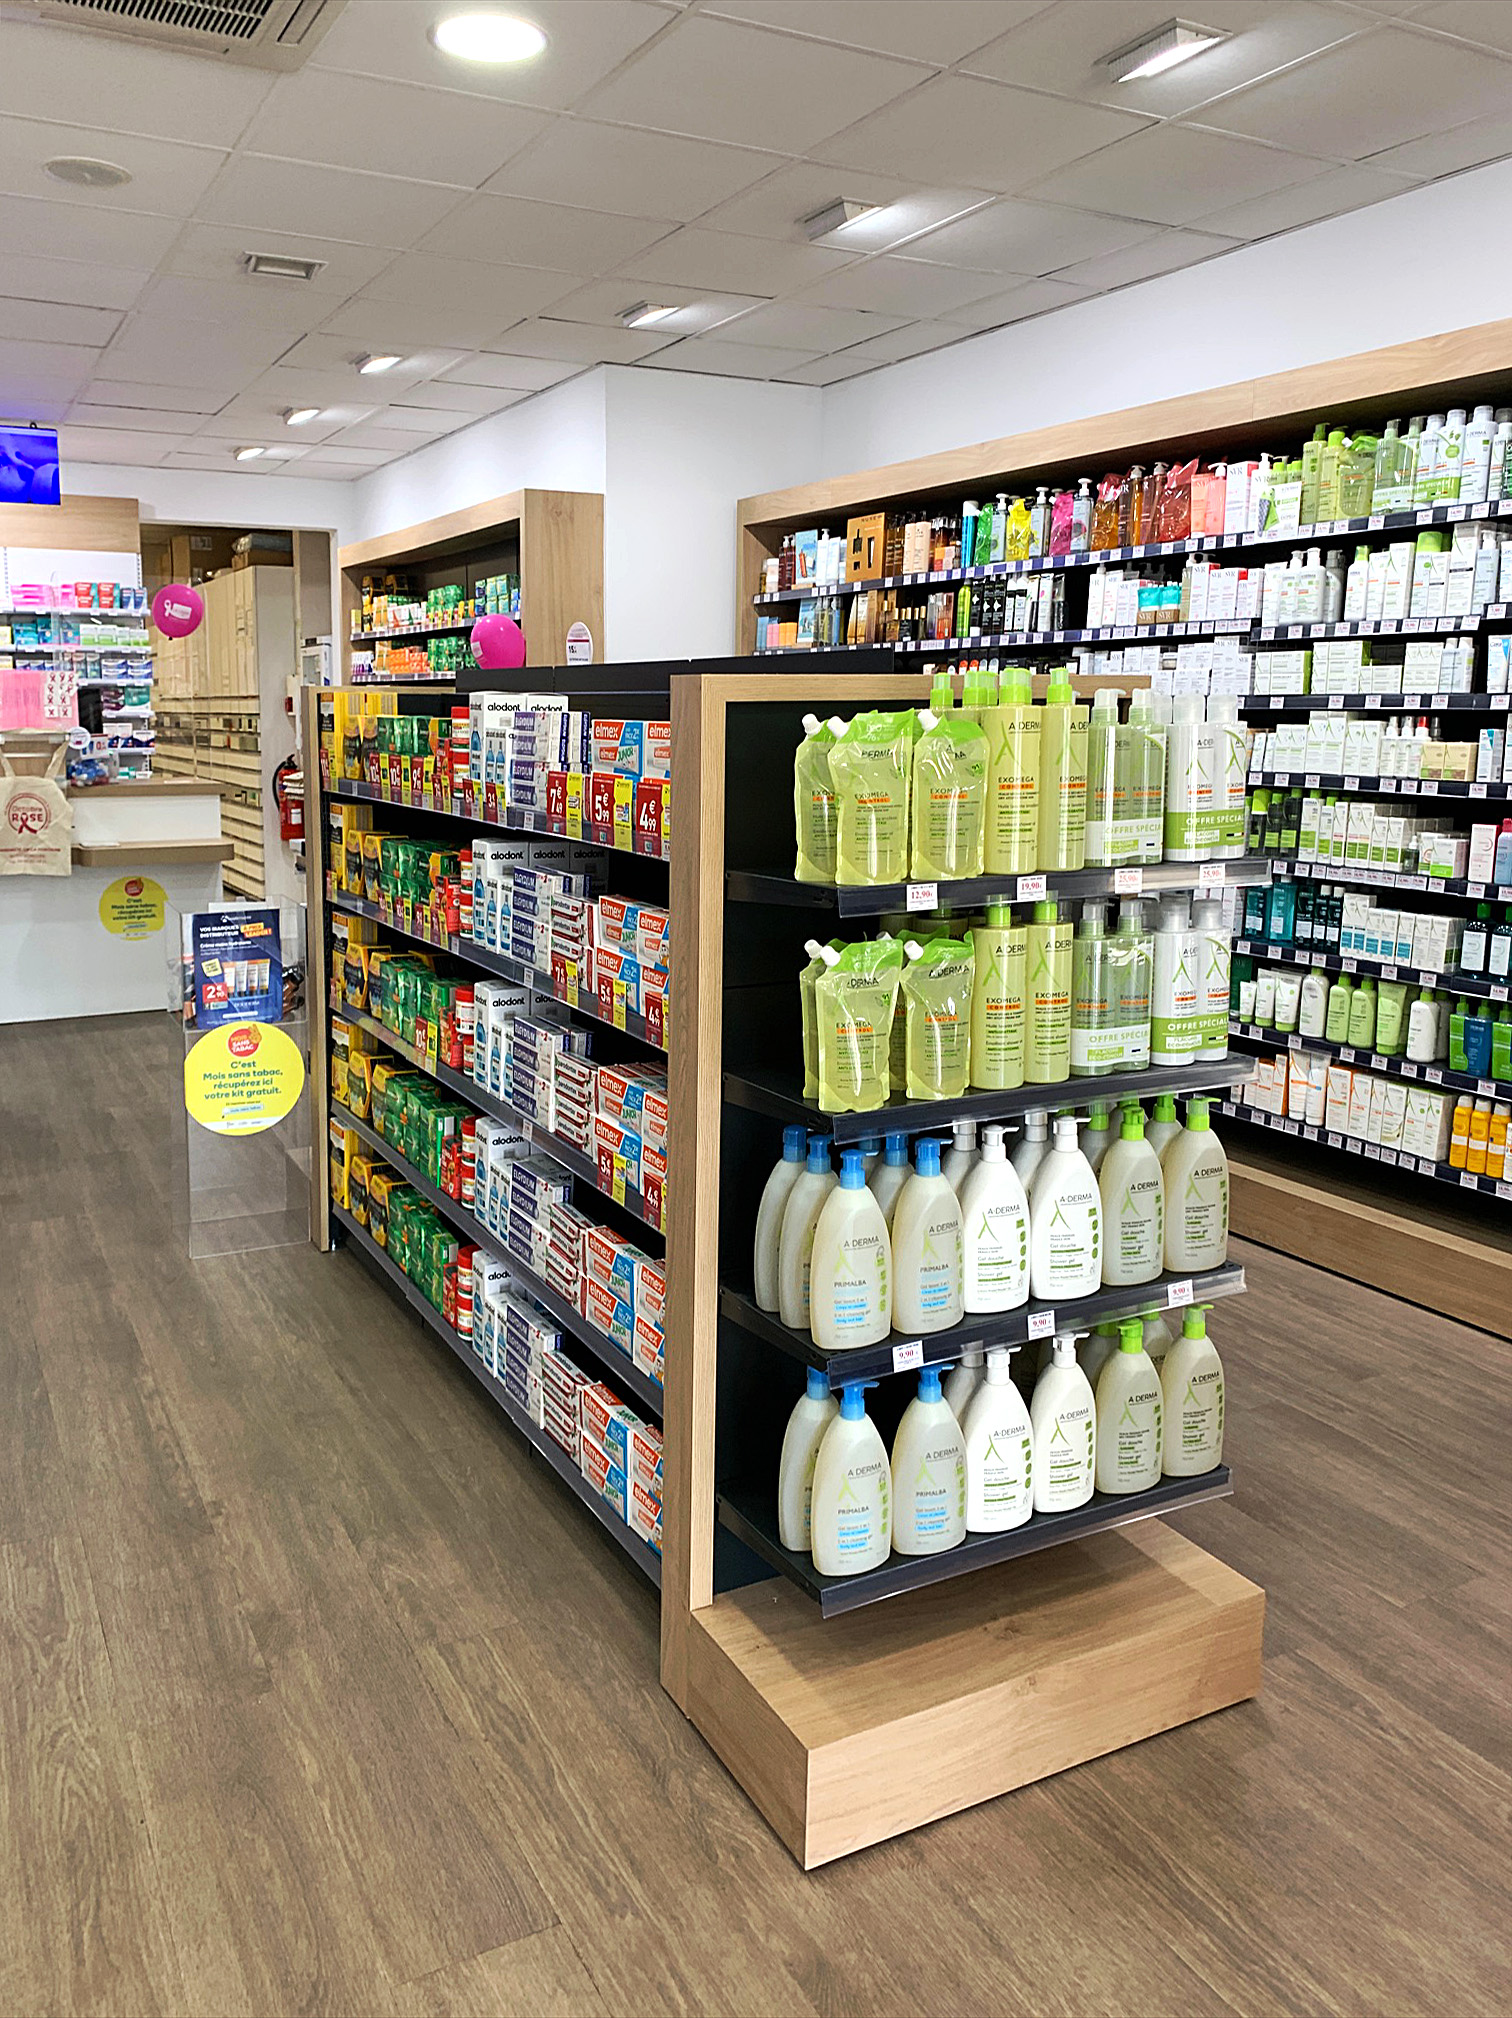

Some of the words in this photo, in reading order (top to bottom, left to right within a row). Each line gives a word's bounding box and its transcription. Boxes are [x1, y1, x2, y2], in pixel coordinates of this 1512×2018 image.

[488, 703, 520, 711] alodont
[595, 724, 619, 738] elmex
[600, 749, 615, 759] elmex
[618, 746, 633, 762] JUNIOR
[491, 851, 524, 859] alodont
[534, 851, 565, 859] alodont
[573, 850, 606, 859] alodont
[601, 902, 622, 920] elmex
[641, 916, 663, 932] elmex
[598, 953, 620, 971] elmex
[644, 969, 664, 987] elmex
[492, 997, 525, 1007] alodont
[1168, 1023, 1198, 1031] OFFRE
[232, 1044, 254, 1052] TABAC
[231, 1061, 256, 1069] C'est
[205, 1091, 229, 1099] votre
[247, 1087, 282, 1098] gratuit.
[214, 1080, 260, 1090] récupérez
[600, 1076, 623, 1096] elmex
[646, 1098, 667, 1117] elmex
[596, 1125, 619, 1145] elmex
[644, 1151, 666, 1169] elmex
[513, 1169, 536, 1190] ELGYDIUM
[590, 1237, 612, 1262] elmex
[920, 1264, 948, 1272] PRIMALBA
[643, 1268, 664, 1294] elmex
[590, 1284, 612, 1310] elmex
[1032, 1319, 1047, 1328] 9,90
[637, 1321, 659, 1346] elmex
[899, 1349, 914, 1359] 9,90
[584, 1395, 606, 1422] elmex
[584, 1441, 605, 1471] elmex
[634, 1437, 658, 1466] elmex
[634, 1486, 657, 1514] elmex
[916, 1489, 947, 1497] PRIMALBA
[838, 1506, 869, 1515] PRIMALBA
